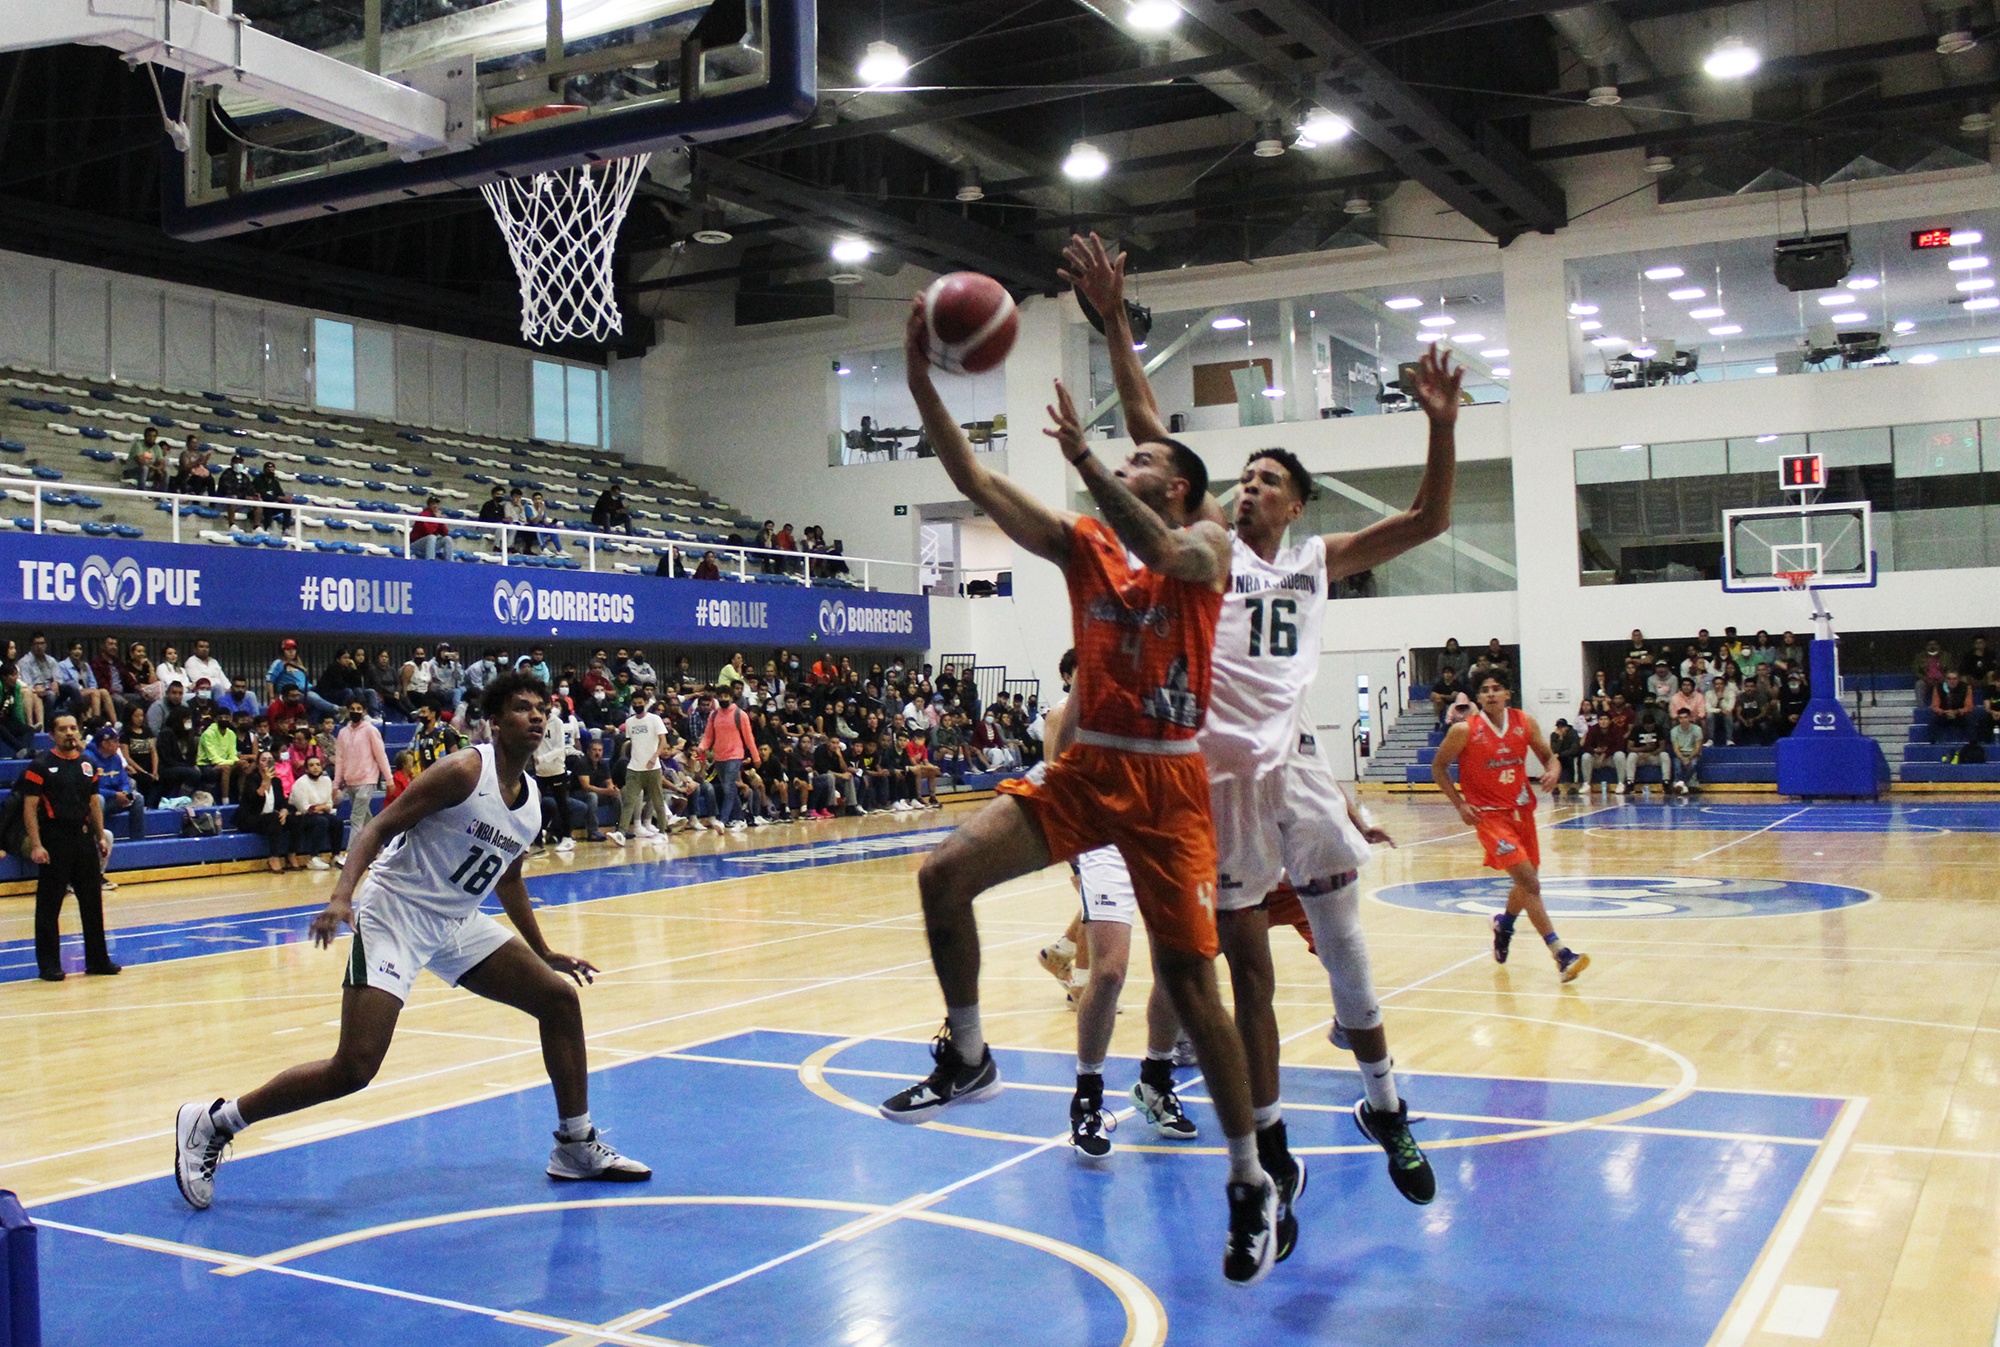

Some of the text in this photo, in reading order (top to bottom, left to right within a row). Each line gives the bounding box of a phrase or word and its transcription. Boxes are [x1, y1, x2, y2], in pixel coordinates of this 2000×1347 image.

[1793, 458, 1820, 484] 11
[19, 560, 202, 606] TEC PUE
[300, 576, 413, 614] #GOBLUE
[1235, 575, 1261, 593] NBA
[537, 589, 635, 624] BORREGOS
[696, 598, 768, 629] #GOBLUE
[848, 607, 913, 634] BORREGOS
[1245, 598, 1298, 657] 16
[474, 821, 523, 857] NBA Academy
[449, 845, 502, 896] 18
[1197, 881, 1214, 922] 4
